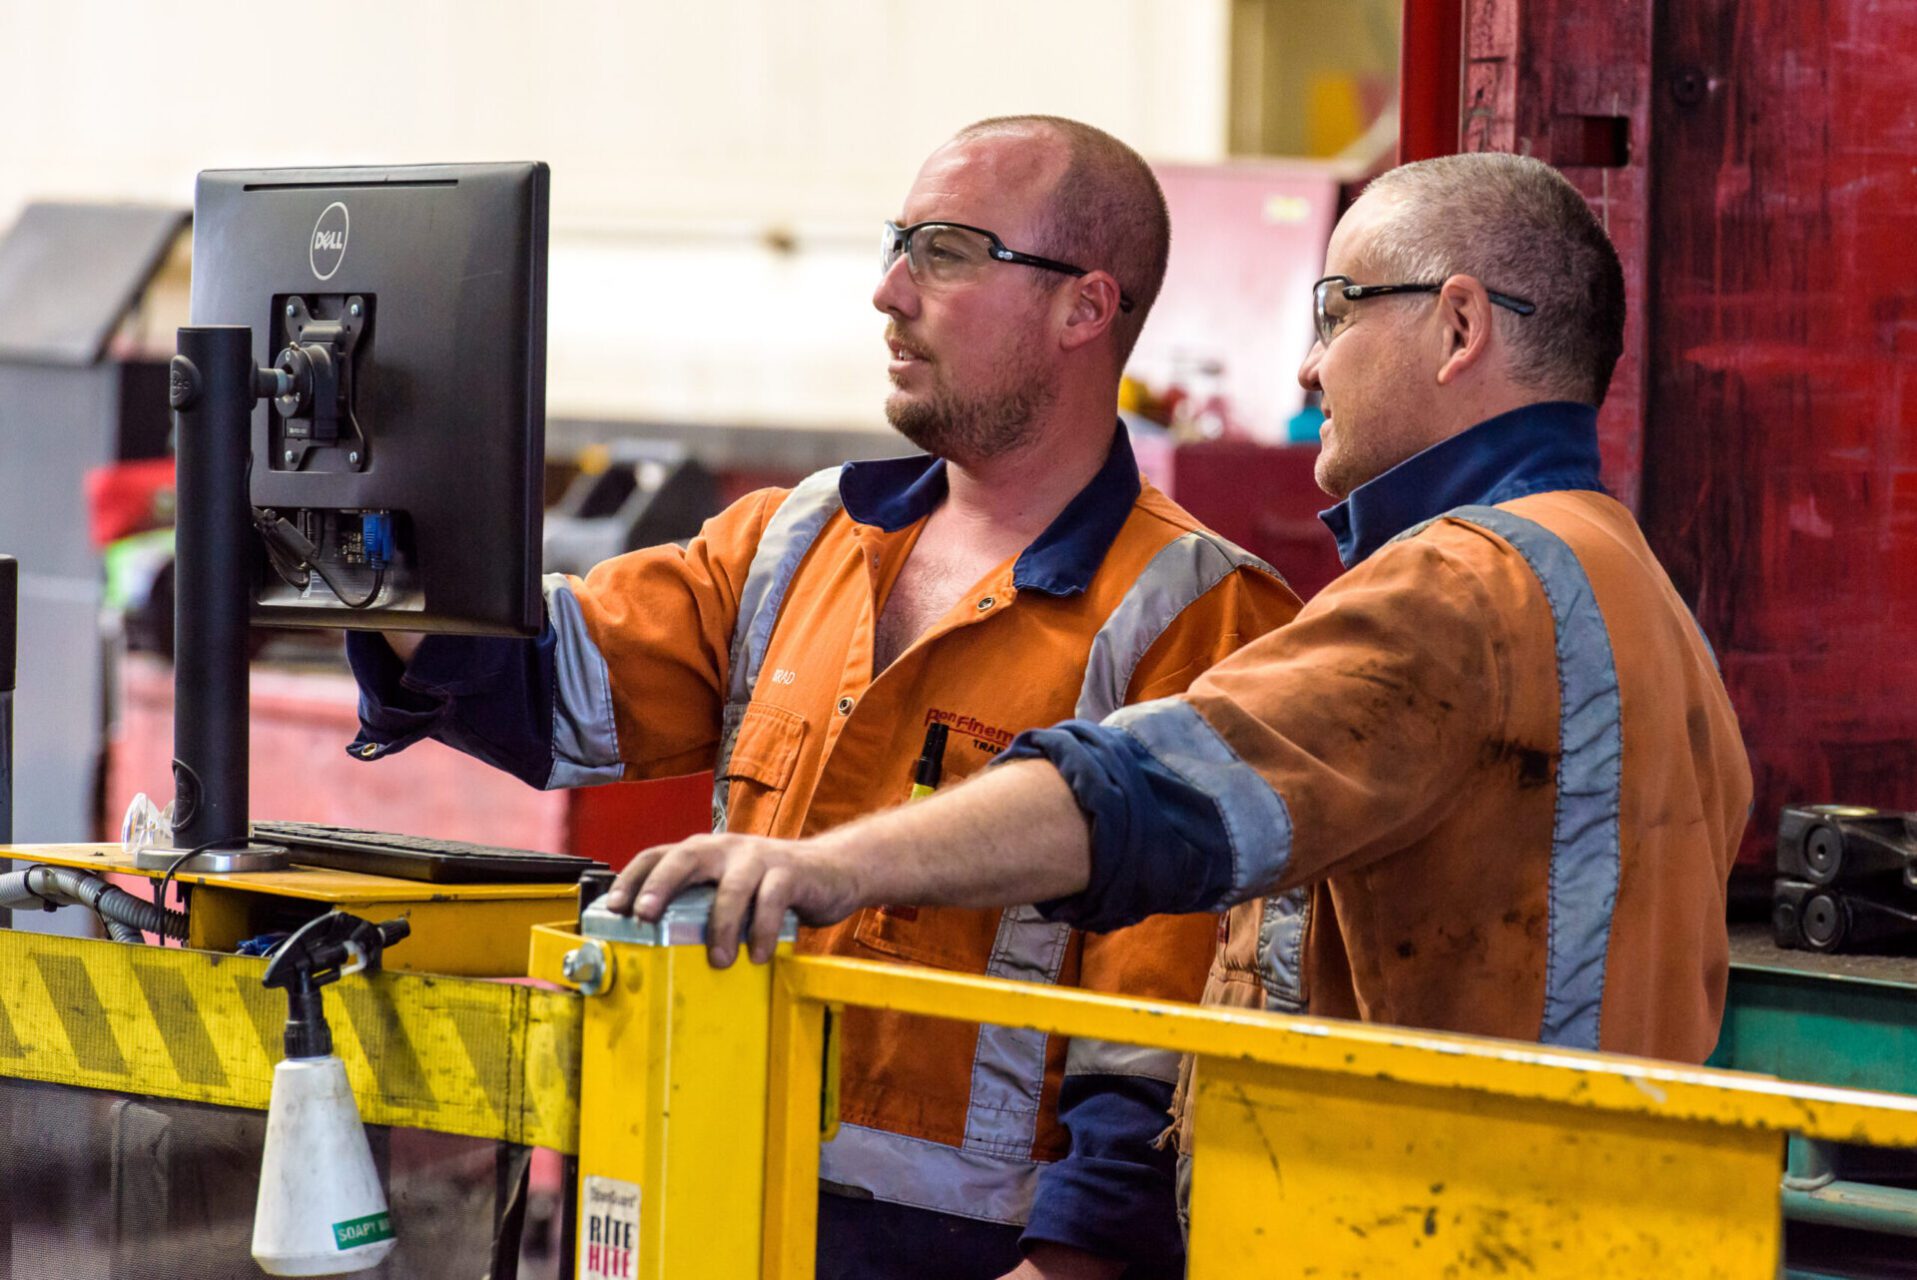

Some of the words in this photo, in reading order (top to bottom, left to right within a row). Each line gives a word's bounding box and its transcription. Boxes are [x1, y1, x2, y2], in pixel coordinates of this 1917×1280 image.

[314, 230, 343, 251] DELL
[956, 715, 1015, 744] Finem
[338, 1221, 377, 1242] SOAPY
[590, 1214, 632, 1249] RITE
[588, 1242, 630, 1278] HITE
